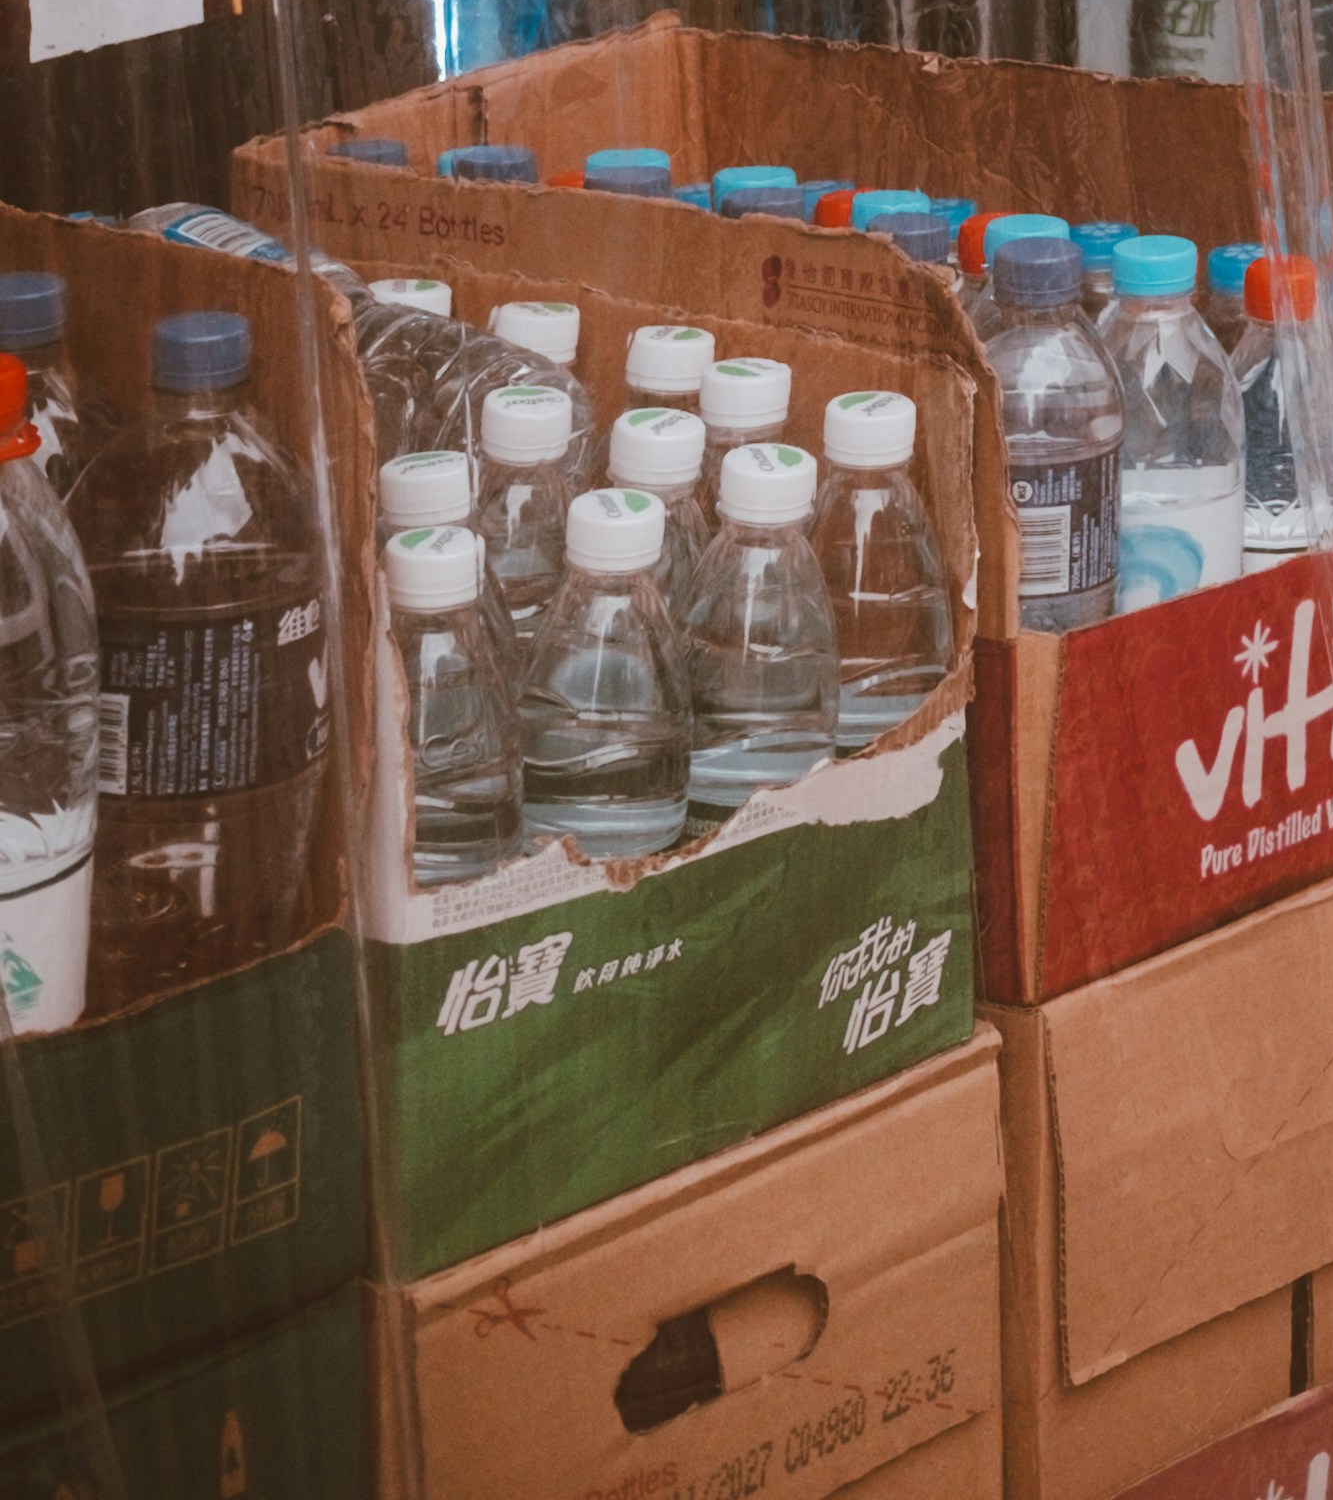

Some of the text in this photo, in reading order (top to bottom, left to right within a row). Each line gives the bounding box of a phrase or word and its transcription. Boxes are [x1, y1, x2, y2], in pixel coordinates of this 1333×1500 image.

[350, 204, 366, 227] x
[377, 202, 409, 231] 24
[419, 205, 506, 248] Bottles
[1201, 844, 1243, 879] Pure
[1247, 803, 1323, 862] Distilled
[436, 930, 573, 1037] 怡寶
[818, 915, 917, 1010] 你我的
[842, 929, 952, 1056] 怡寶
